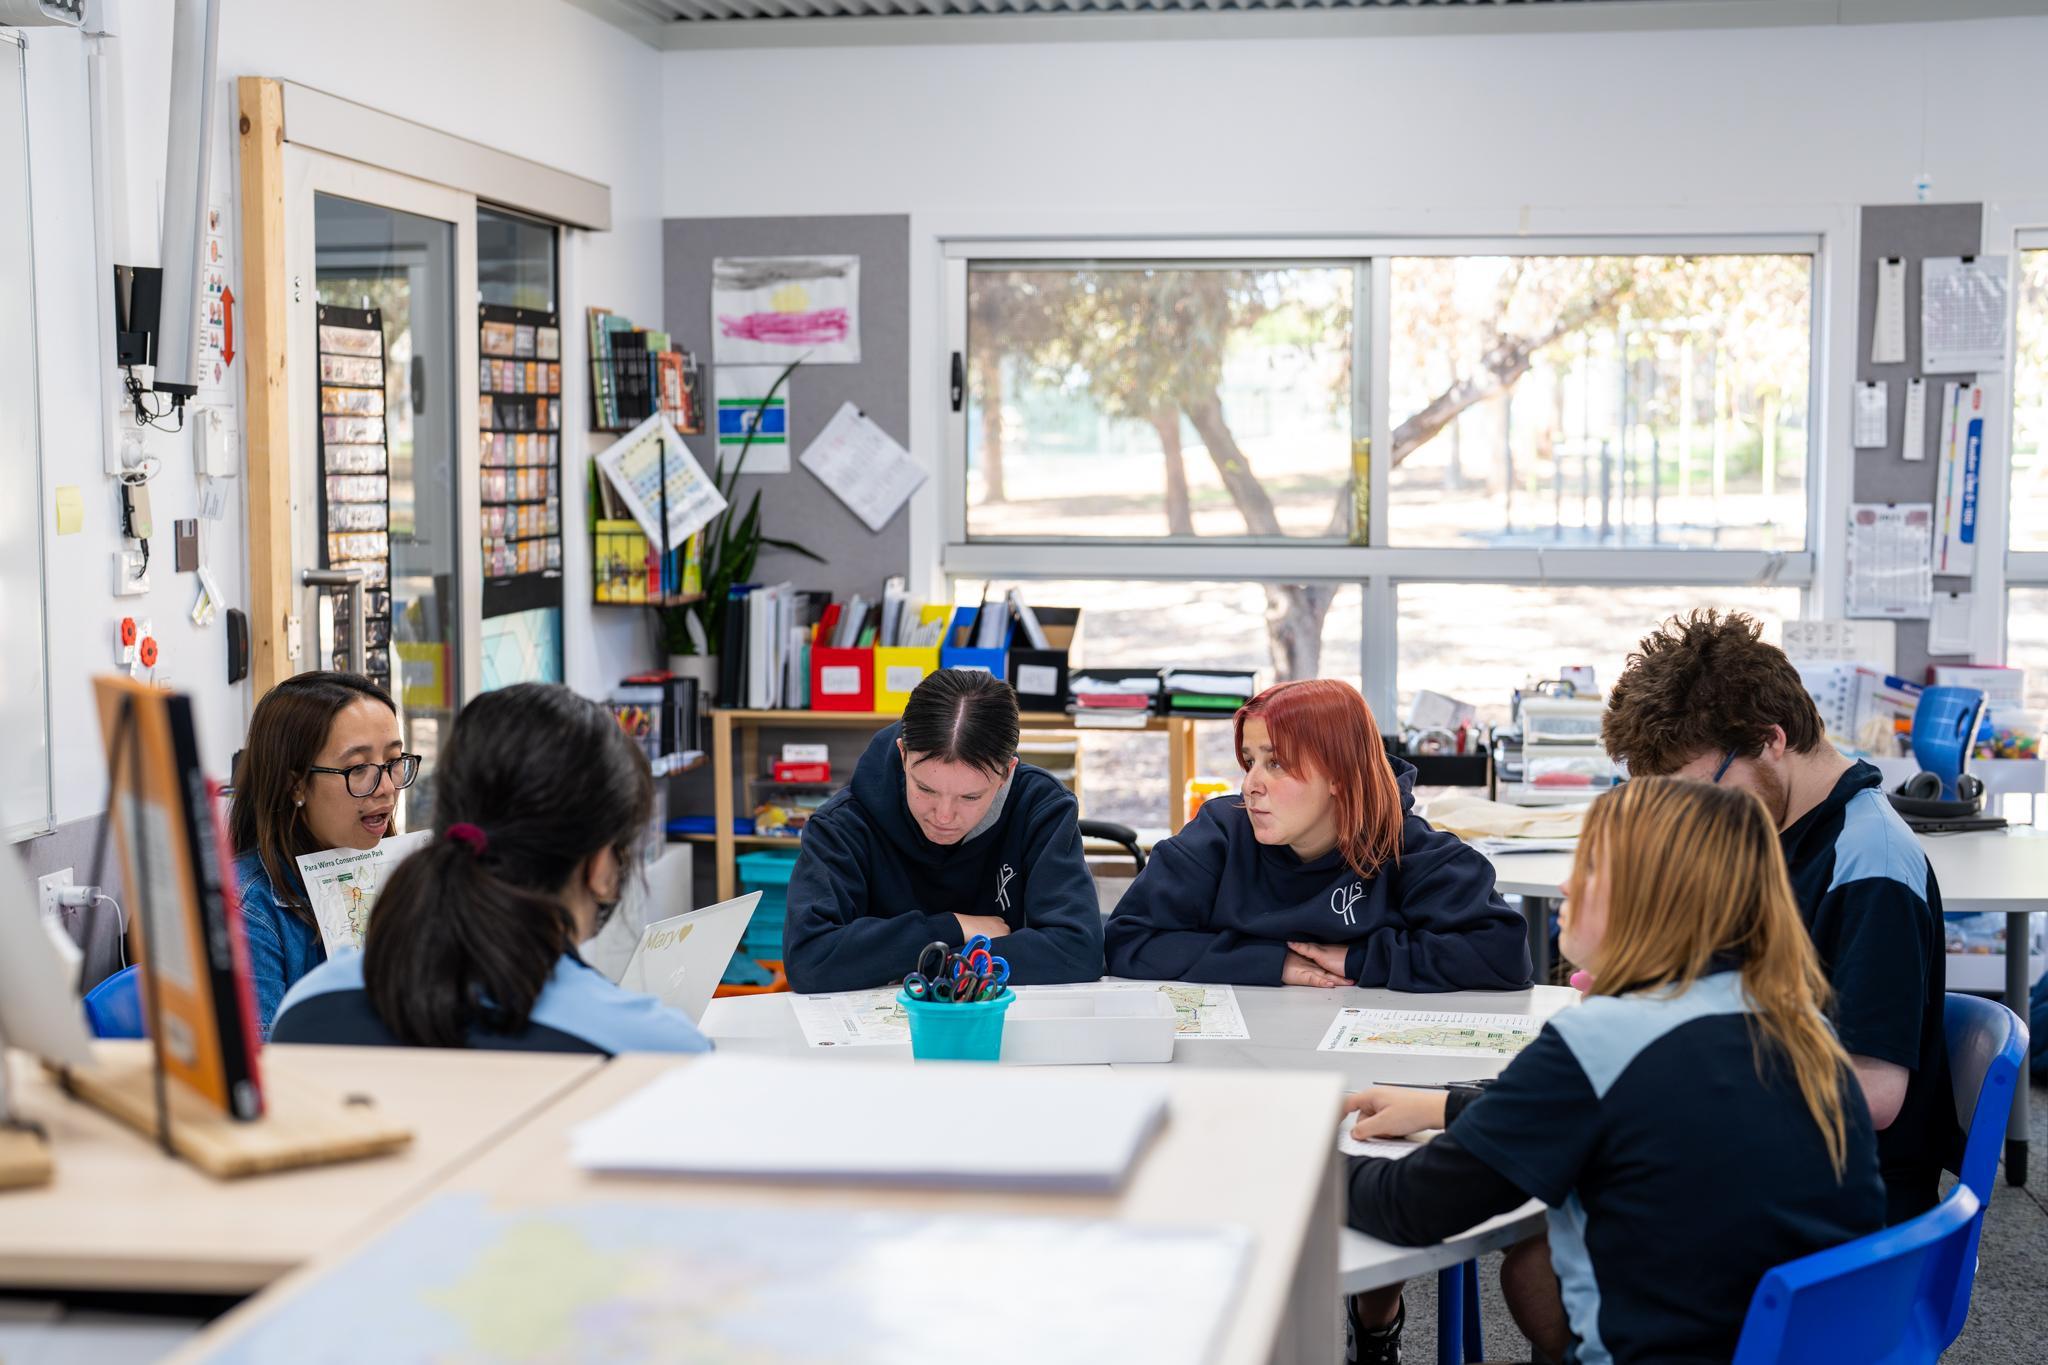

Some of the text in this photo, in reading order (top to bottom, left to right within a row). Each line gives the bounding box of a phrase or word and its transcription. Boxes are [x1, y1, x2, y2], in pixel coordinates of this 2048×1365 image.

[304, 849, 383, 872] Para Wirra Conservation Park
[642, 929, 678, 953] Mary
